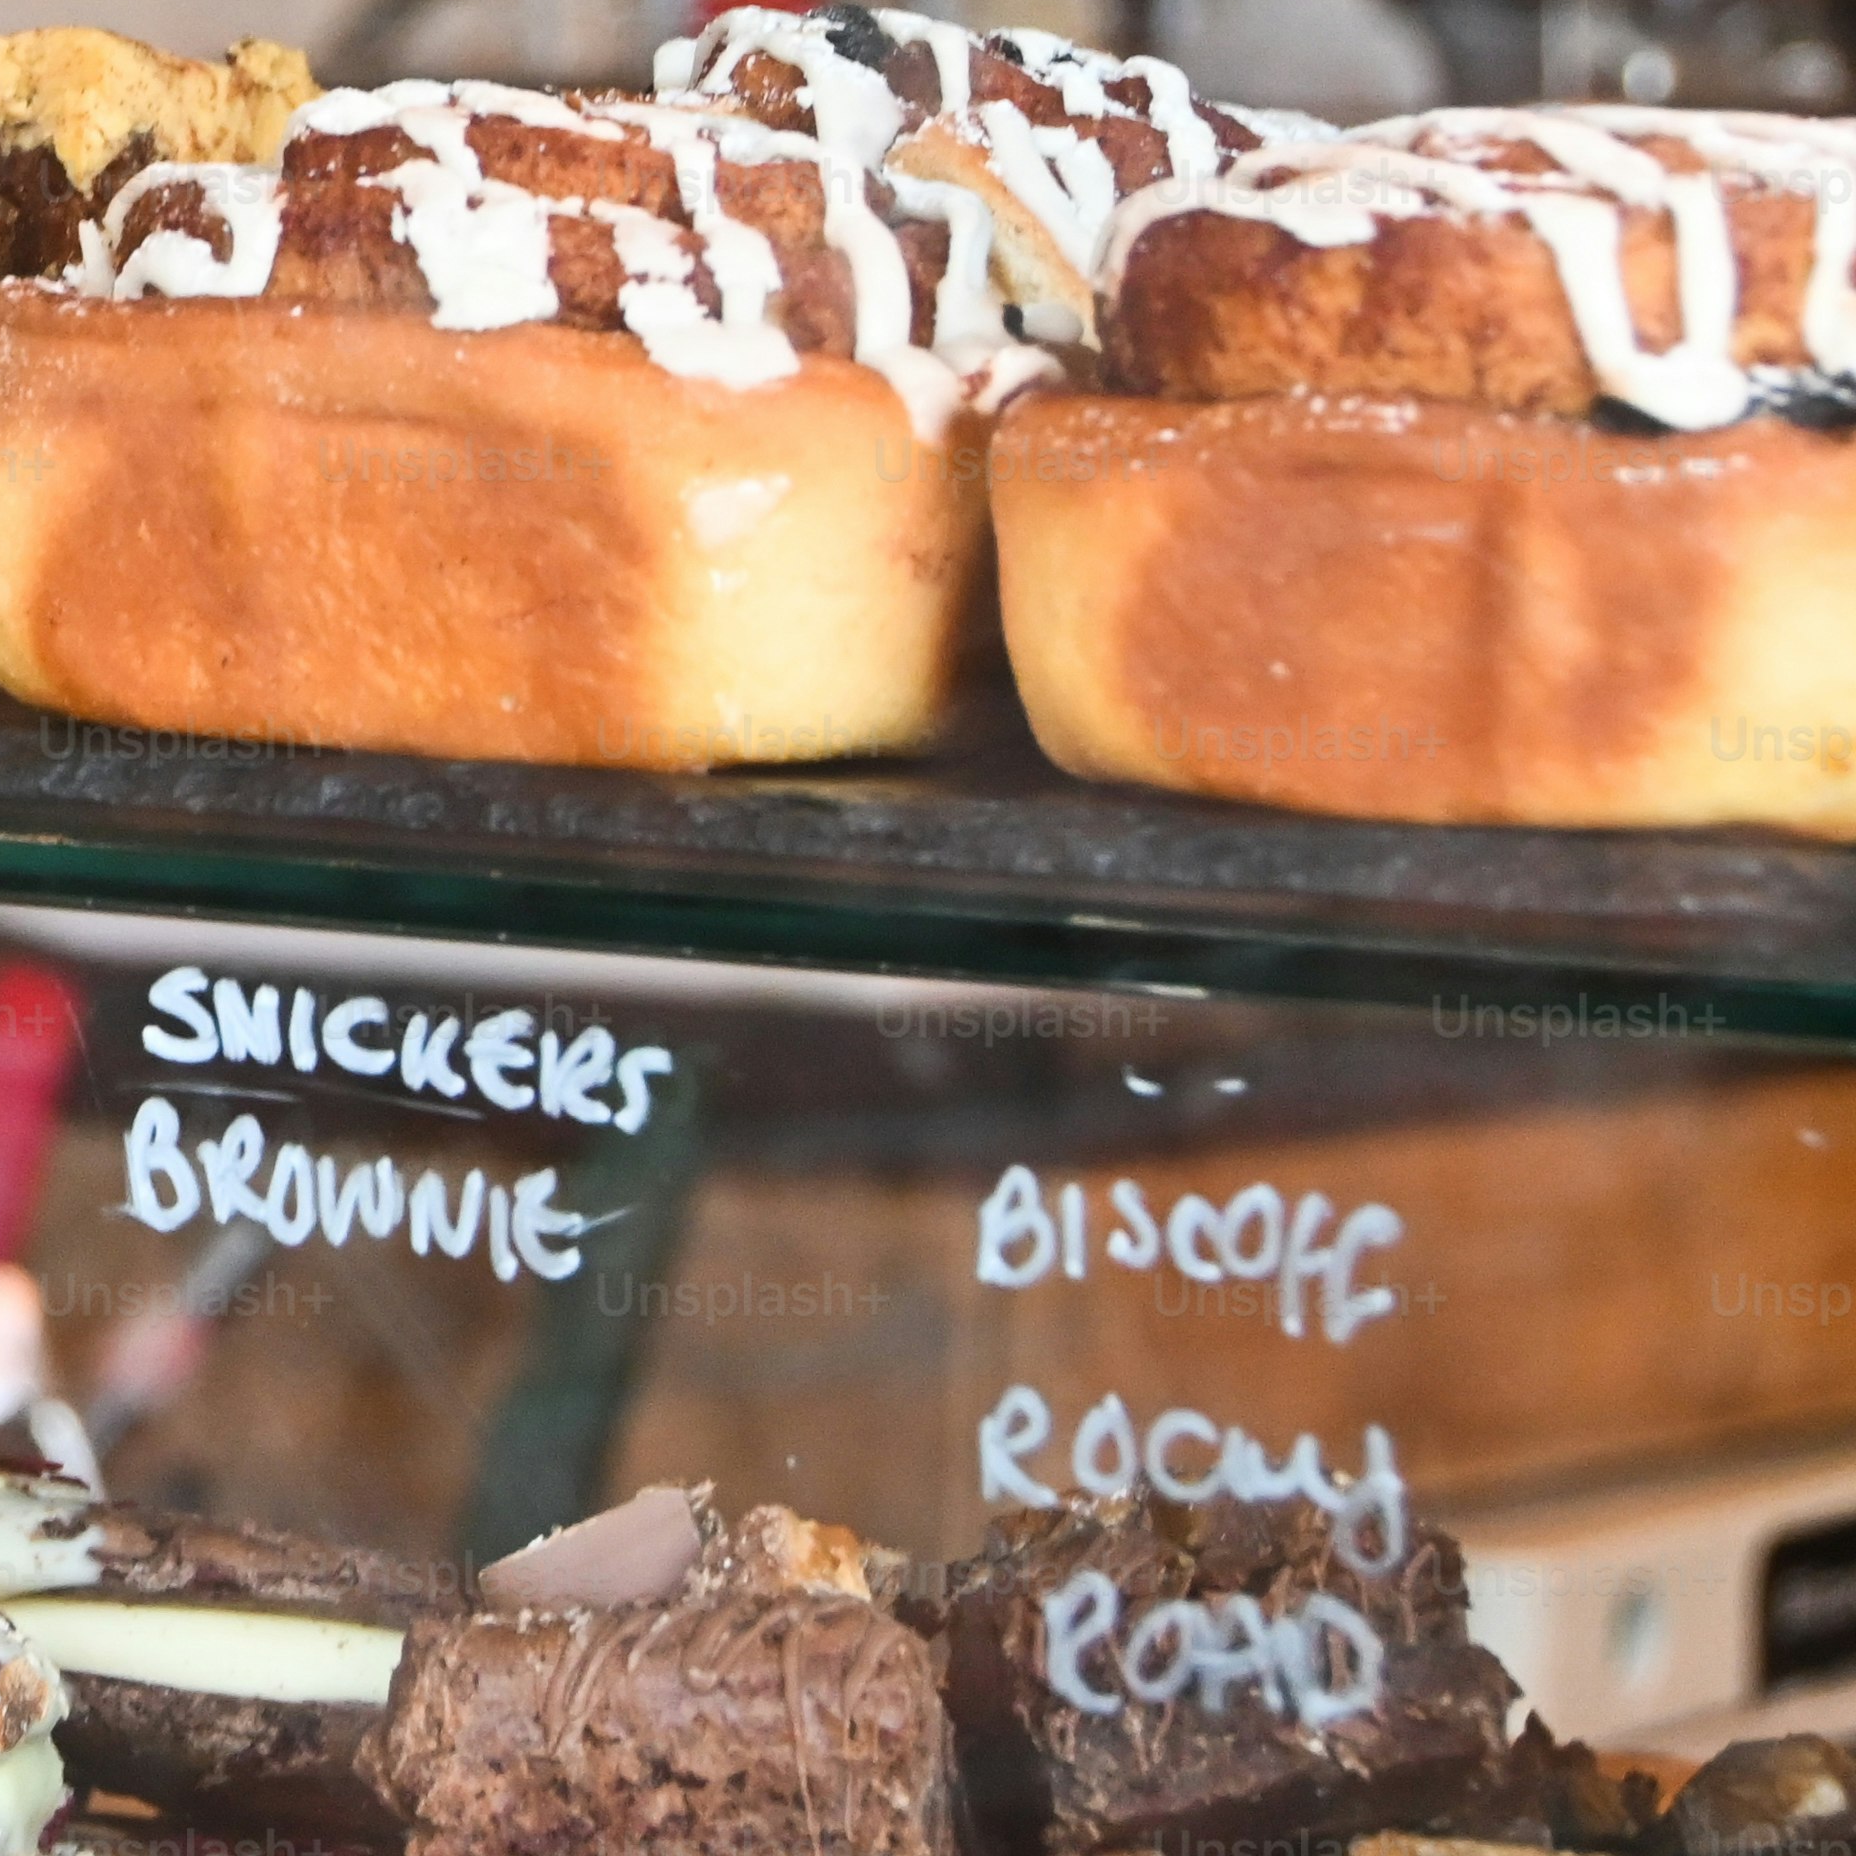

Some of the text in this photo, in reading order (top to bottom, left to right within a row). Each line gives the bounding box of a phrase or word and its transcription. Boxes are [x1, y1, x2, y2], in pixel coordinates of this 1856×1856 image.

[143, 967, 672, 1134] SNICKERS
[125, 1097, 584, 1282] BROWNIE
[977, 1164, 1404, 1346] BISCOFF
[1044, 1569, 1384, 1729] ROAD
